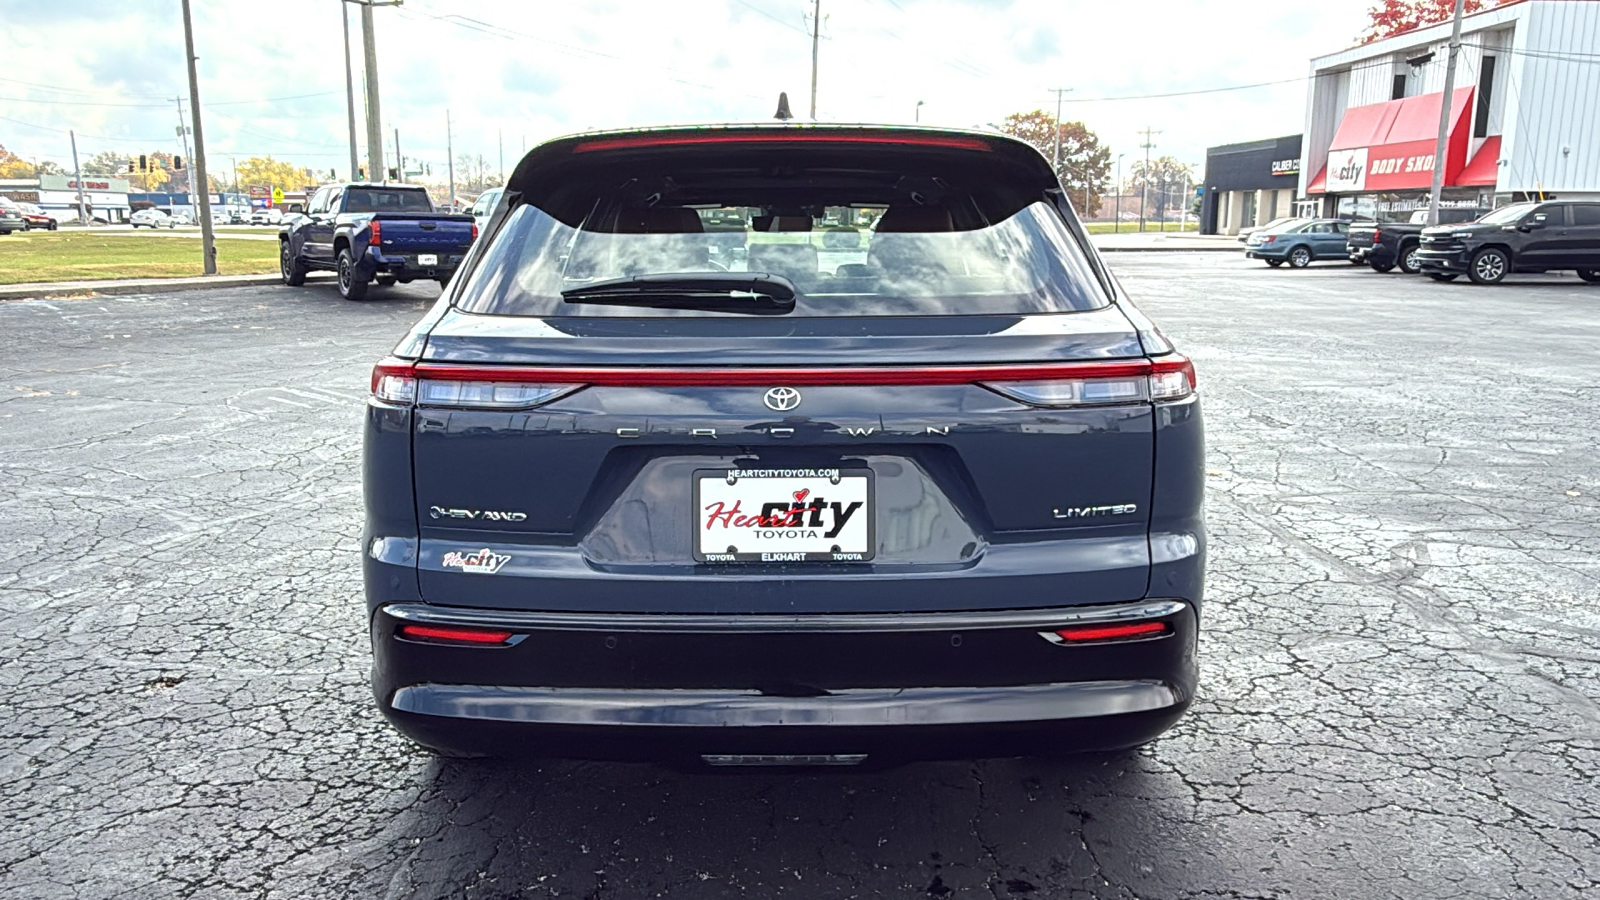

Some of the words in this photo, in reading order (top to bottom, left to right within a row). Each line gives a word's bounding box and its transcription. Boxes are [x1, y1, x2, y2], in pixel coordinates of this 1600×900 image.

[1272, 160, 1292, 172] CALIBER
[1370, 158, 1405, 175] BODY
[1340, 161, 1364, 185] city
[12, 192, 36, 201] WASH
[616, 426, 950, 439] CROWN
[727, 469, 839, 478] HEARTCITYTOYOTA.COM
[481, 510, 528, 521] AWD
[704, 499, 818, 530] Heart
[1053, 504, 1137, 518] LIMITED
[758, 496, 864, 539] city
[753, 530, 818, 539] TOYOTA
[761, 552, 807, 561] ELKHART
[833, 553, 863, 561] TOYOTA
